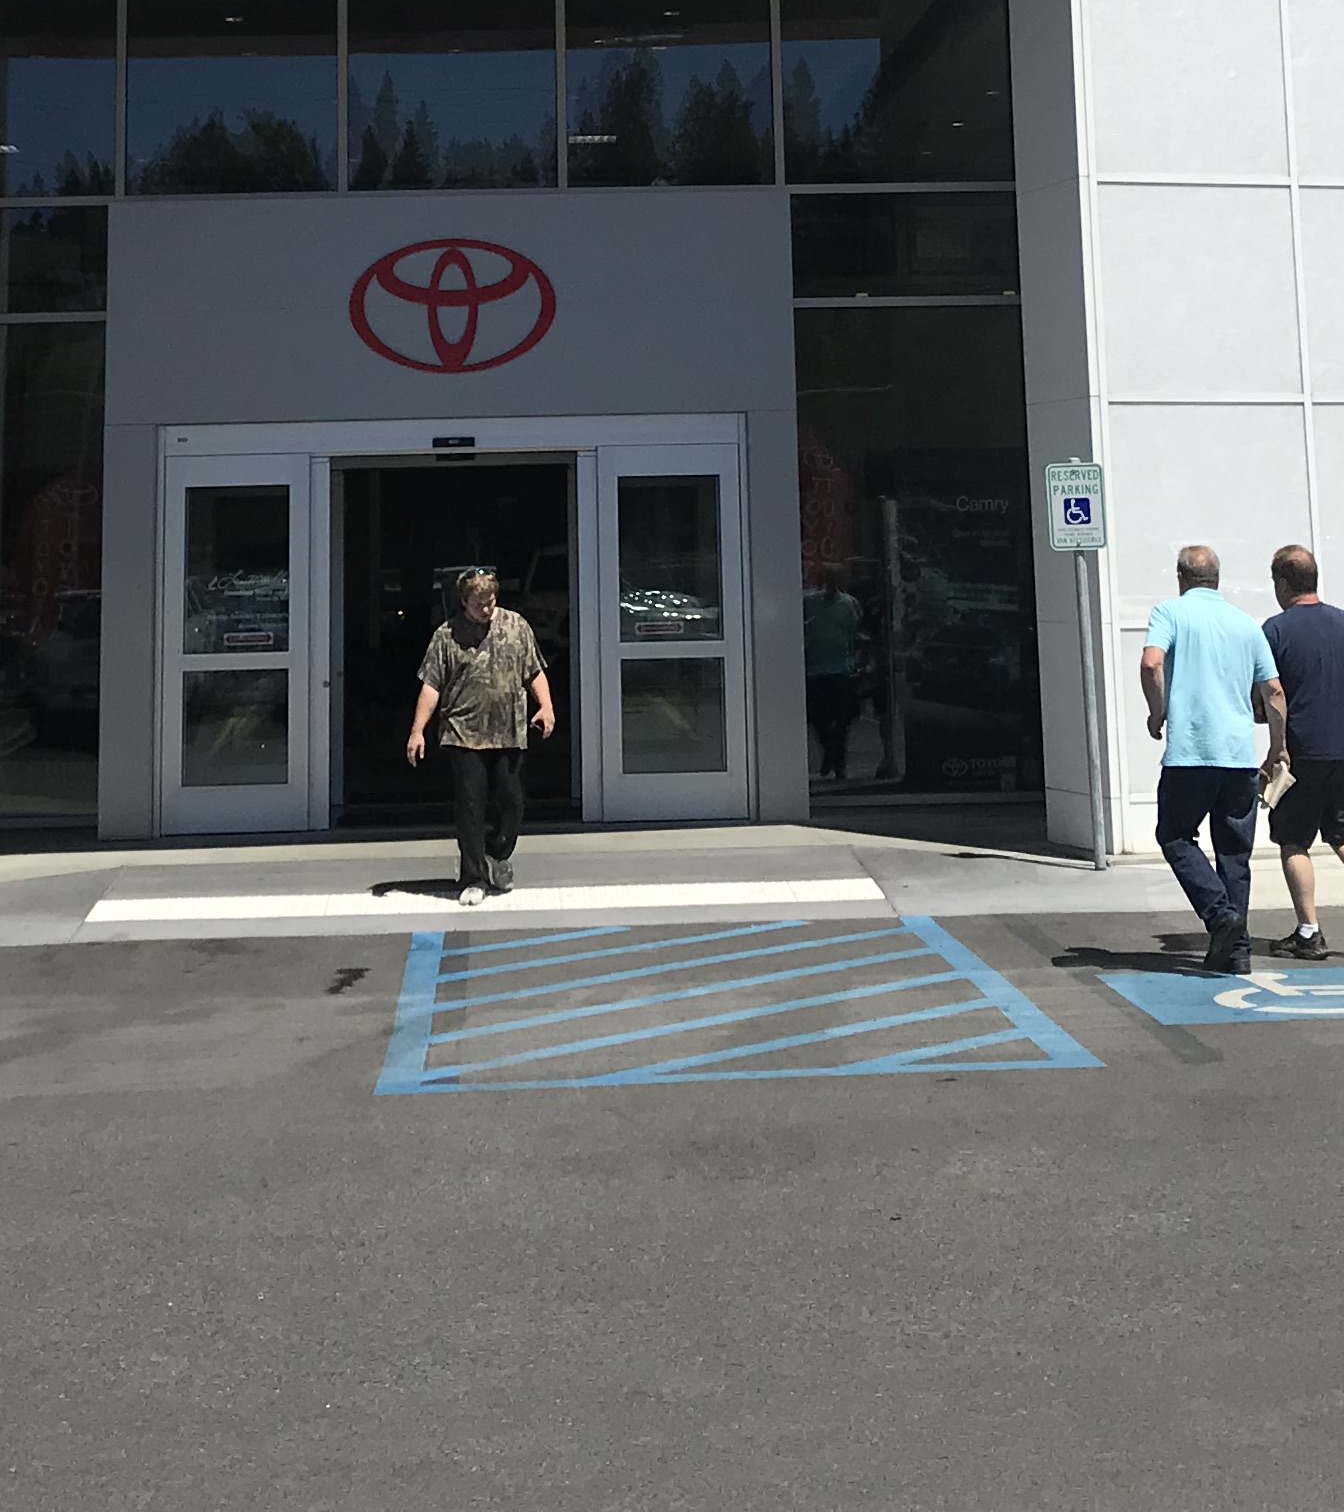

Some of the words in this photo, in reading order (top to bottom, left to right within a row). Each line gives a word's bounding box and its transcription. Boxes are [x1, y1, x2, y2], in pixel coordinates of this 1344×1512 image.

[1051, 469, 1099, 482] RESERVED
[1053, 484, 1099, 496] PARKING
[956, 495, 1009, 514] Camry
